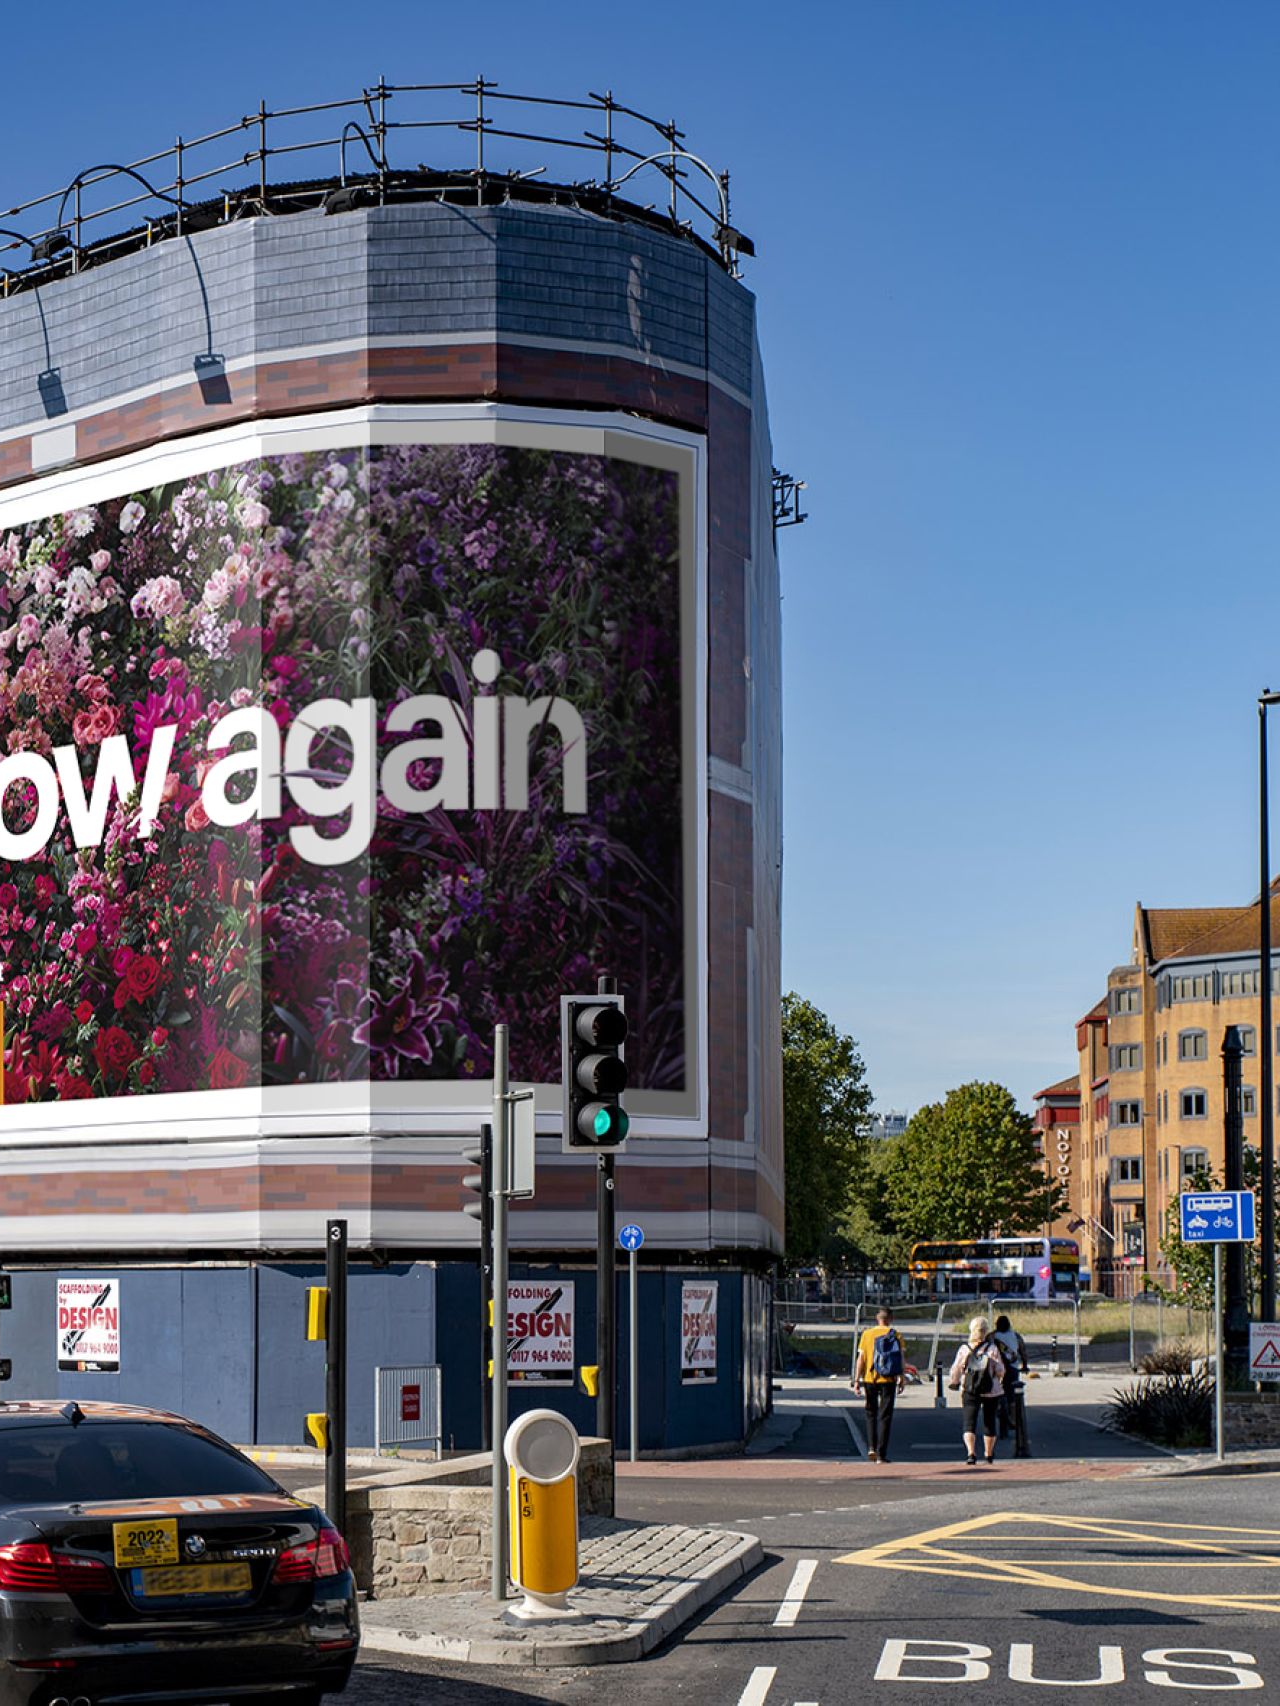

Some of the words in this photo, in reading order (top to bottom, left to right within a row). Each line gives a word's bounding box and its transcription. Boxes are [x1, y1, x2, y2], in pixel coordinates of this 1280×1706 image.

[202, 649, 588, 866] again
[1057, 1129, 1070, 1198] NOVOTE
[606, 1178, 615, 1190] 6
[331, 1226, 341, 1240] 3
[1188, 1230, 1205, 1238] taxi
[59, 1284, 104, 1294] SCAFFOLDING
[507, 1288, 551, 1299] FOLDING
[59, 1307, 118, 1330] DESIGN
[507, 1313, 571, 1337] ESIGN
[511, 1351, 529, 1362] 0117
[531, 1351, 548, 1362] 964
[551, 1351, 572, 1362] 9000
[128, 1529, 165, 1547] 2022
[874, 1638, 1265, 1690] BUS
